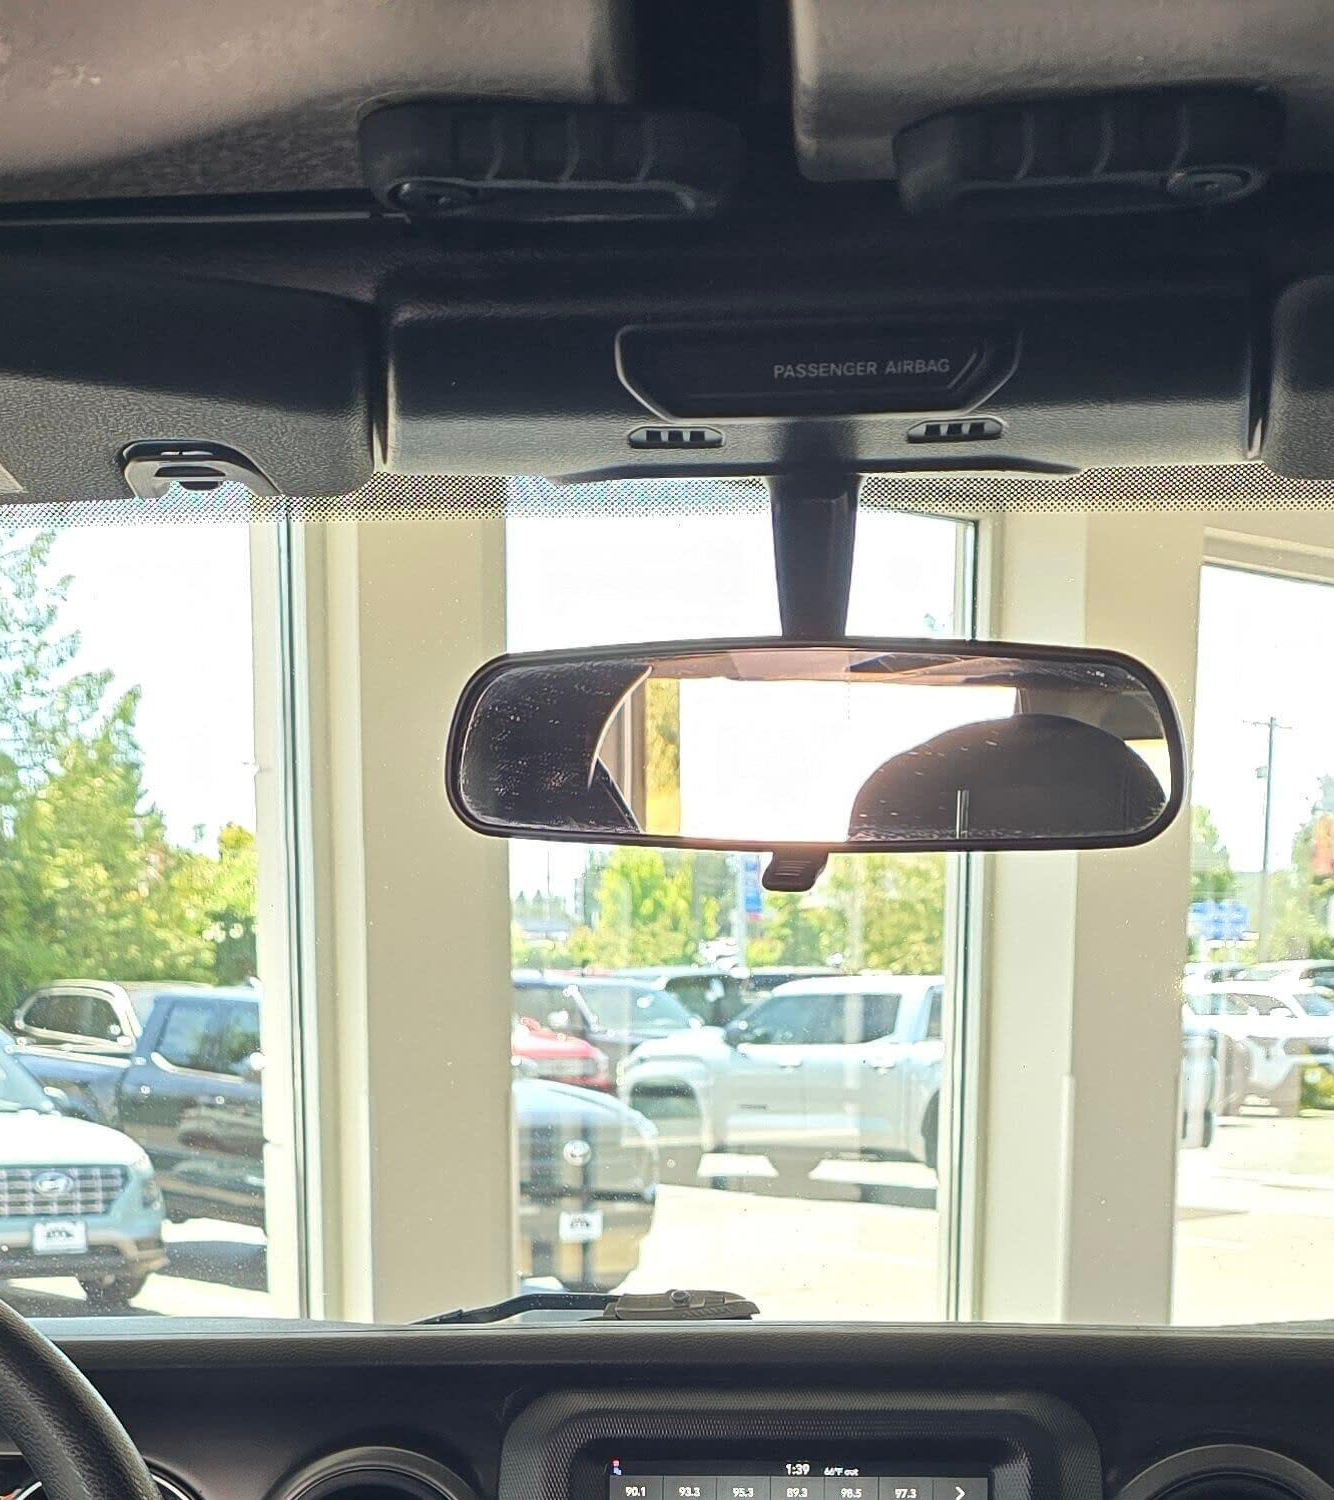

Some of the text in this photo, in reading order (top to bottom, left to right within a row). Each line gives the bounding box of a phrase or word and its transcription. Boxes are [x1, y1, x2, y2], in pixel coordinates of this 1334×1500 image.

[773, 358, 951, 379] PASSENGER AIRBAG
[785, 1463, 810, 1476] 1:39
[625, 1486, 646, 1498] 90.1
